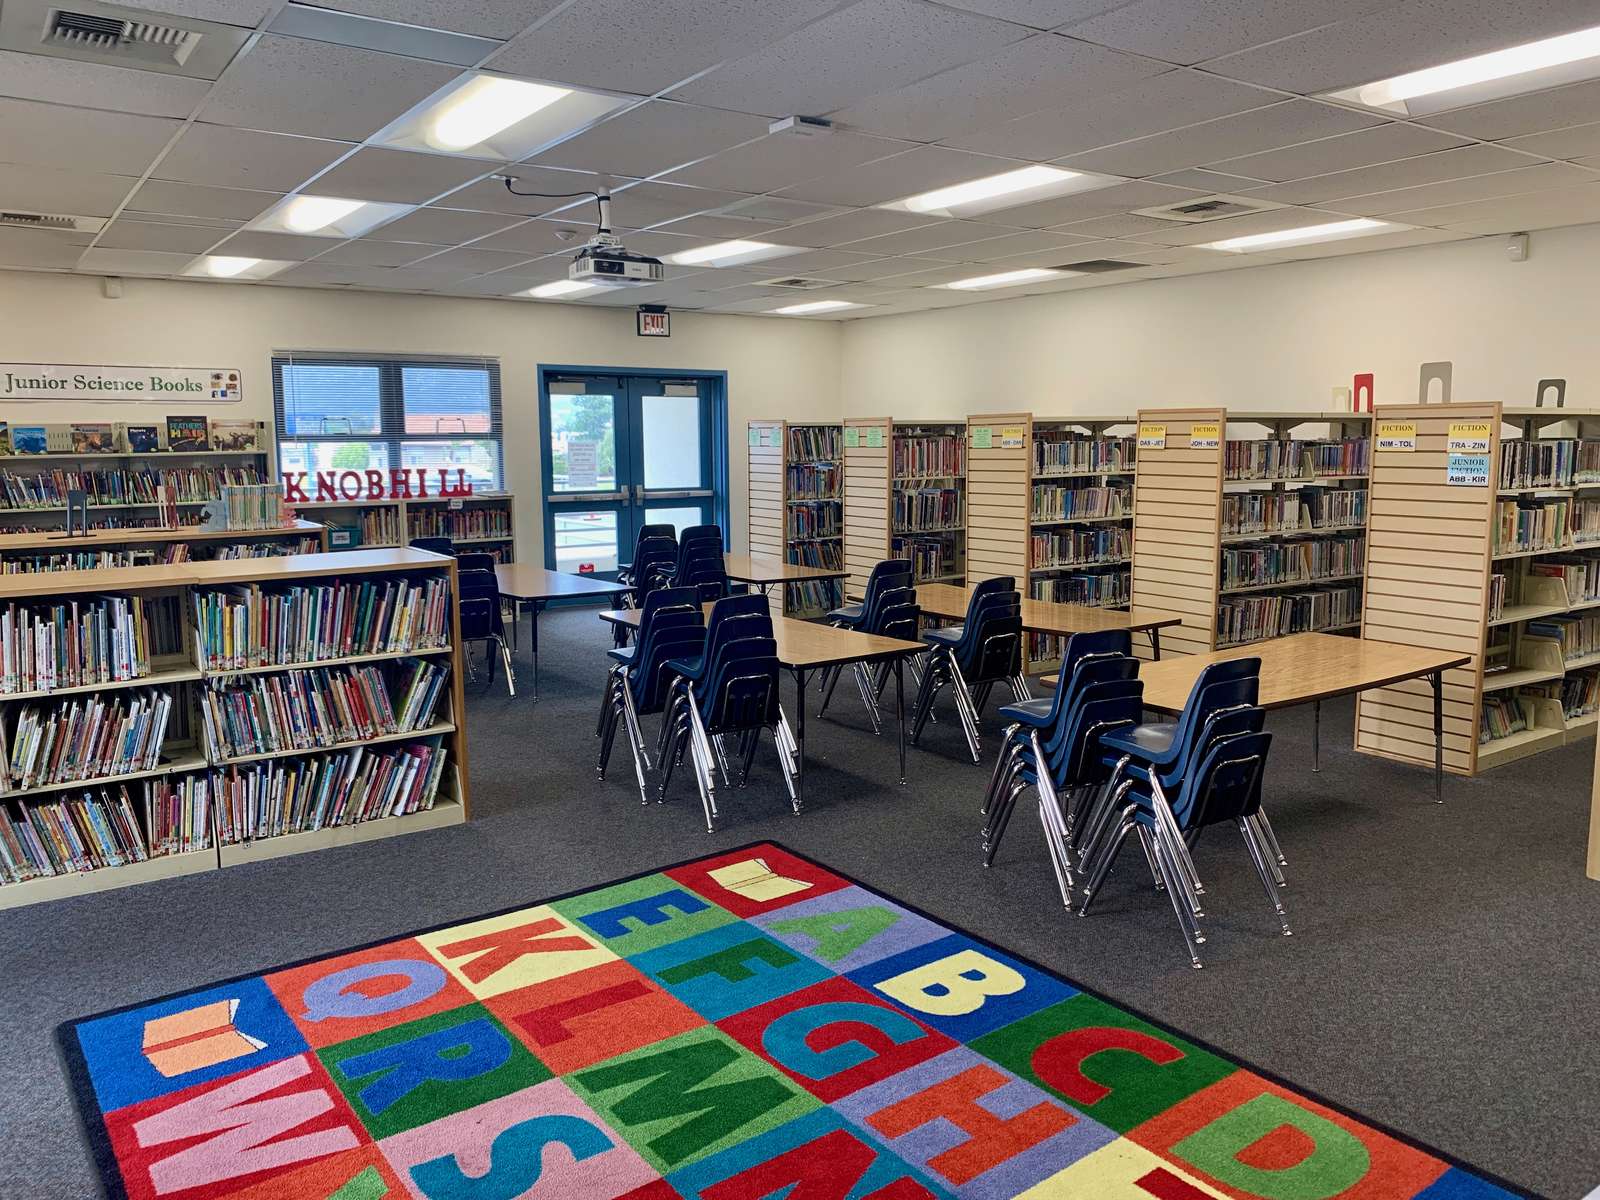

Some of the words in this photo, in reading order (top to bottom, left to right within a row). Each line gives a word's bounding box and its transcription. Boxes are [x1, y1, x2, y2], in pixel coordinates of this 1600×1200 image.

[5, 373, 68, 393] Junior
[73, 374, 144, 391] Science
[149, 376, 203, 392] Books
[1380, 440, 1394, 448] NIM
[1399, 440, 1413, 448] TOL
[1381, 424, 1414, 432] FICTION
[1450, 441, 1467, 449] TRA
[1452, 458, 1485, 466] JUNIOR
[435, 916, 597, 984] K
[301, 959, 446, 1023] Q
[513, 978, 655, 1048] L
[340, 1018, 513, 1116] R
[576, 888, 711, 939] E
[655, 936, 798, 987] F
[761, 1001, 929, 1081] G
[865, 1063, 1079, 1187] H
[768, 905, 903, 964] A
[873, 949, 1027, 1017] B
[1031, 1026, 1185, 1107] C
[1168, 1092, 1373, 1200] D
[131, 1053, 362, 1196] W
[573, 1038, 798, 1167] M
[408, 1113, 617, 1200] S
